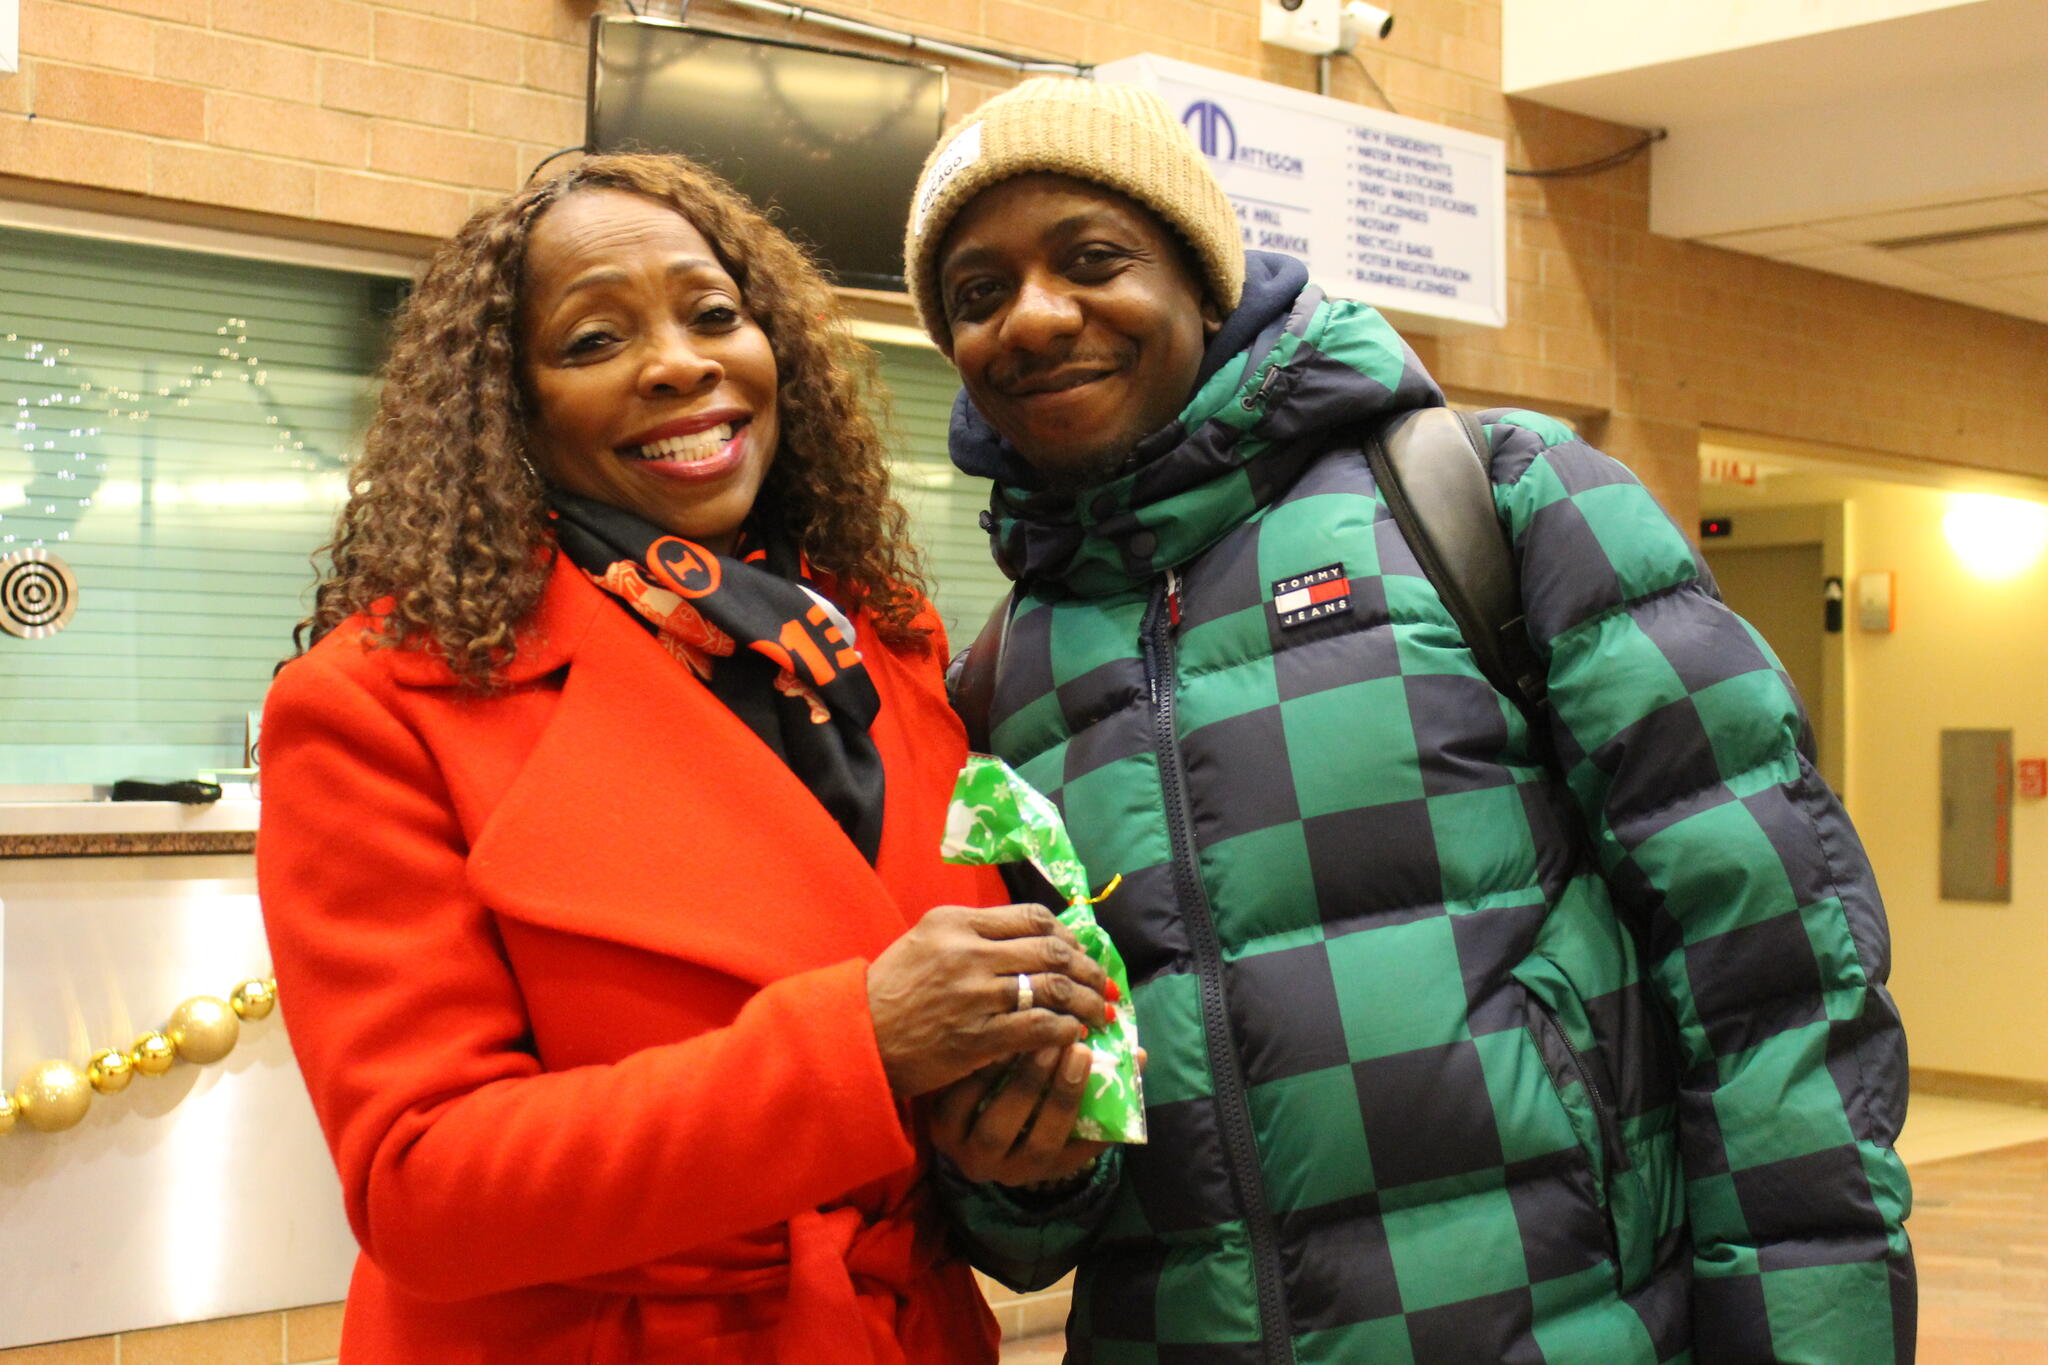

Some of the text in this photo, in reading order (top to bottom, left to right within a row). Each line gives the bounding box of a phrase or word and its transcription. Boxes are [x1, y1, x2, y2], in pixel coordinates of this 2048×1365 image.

[1385, 134, 1442, 158] RESIDENTS
[1358, 164, 1401, 182] VEHICLE
[1396, 155, 1452, 178] PAYMENTS
[1391, 189, 1425, 205] WASTE
[1356, 198, 1429, 224] PET LICENSES
[1356, 216, 1400, 234] NOTARY
[1259, 230, 1309, 254] SERVICE
[1356, 234, 1401, 253] RECYCLE
[1395, 259, 1470, 281] REGISTRATION
[1356, 269, 1457, 298] BUSINESS LICENSES
[1277, 568, 1340, 592] TOMMY
[1285, 600, 1347, 624] JEANS
